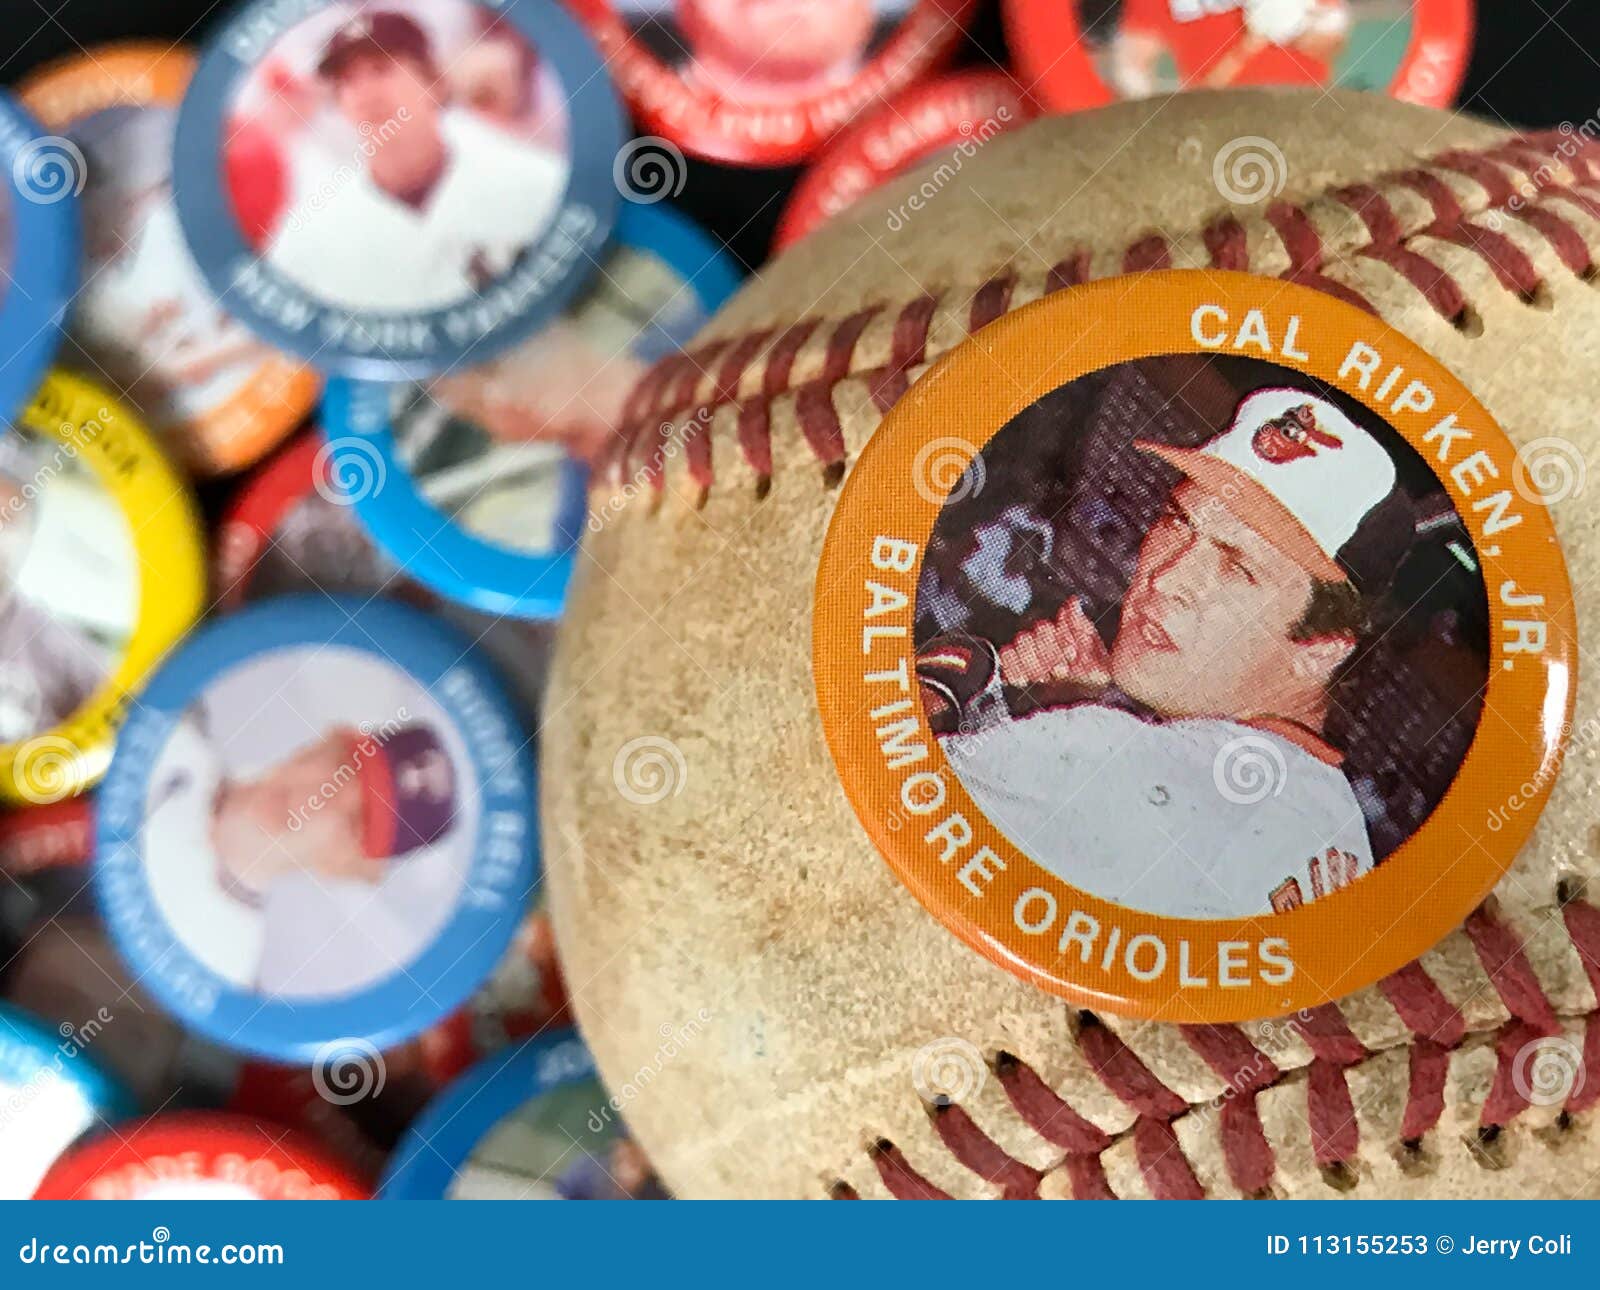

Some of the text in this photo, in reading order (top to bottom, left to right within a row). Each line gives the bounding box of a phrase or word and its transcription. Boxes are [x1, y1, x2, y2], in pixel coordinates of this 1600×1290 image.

[1190, 303, 1547, 671] CAL RIPKEN, JR.
[862, 535, 1296, 989] BALTIMORE ORIOLES
